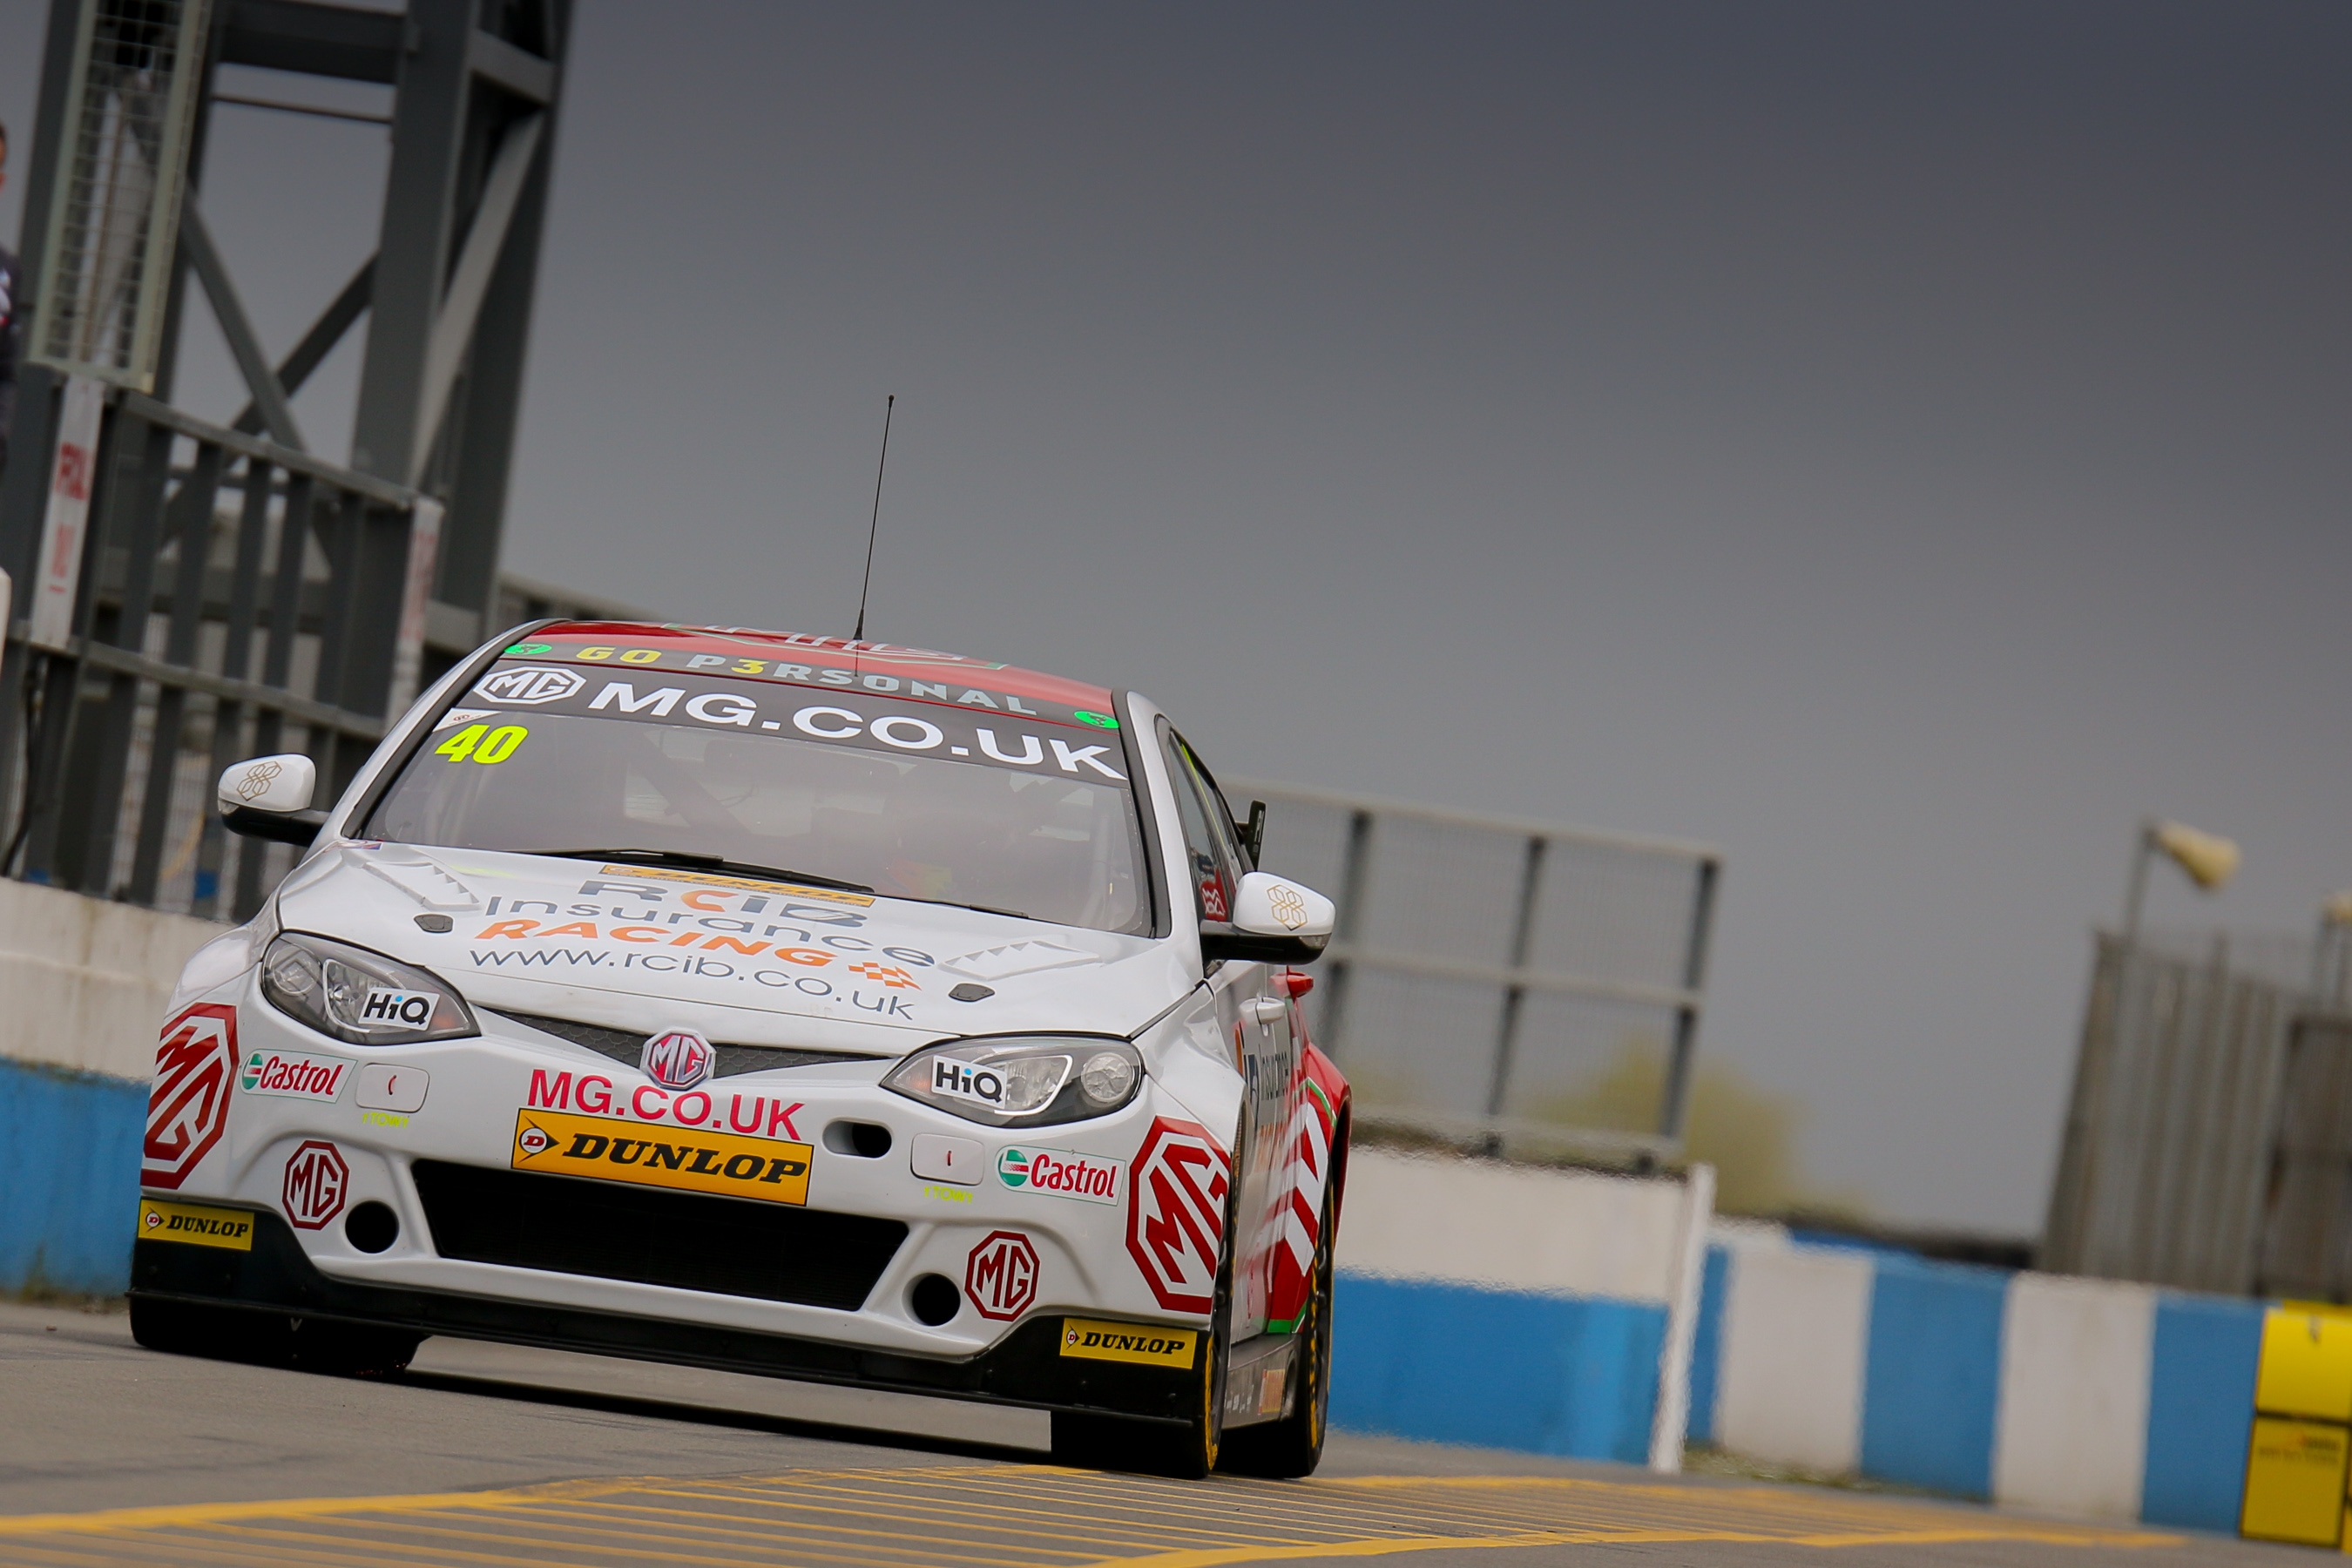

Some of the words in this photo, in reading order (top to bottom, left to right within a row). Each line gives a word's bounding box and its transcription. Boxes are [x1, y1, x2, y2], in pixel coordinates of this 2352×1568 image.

[576, 646, 661, 665] GO
[686, 653, 1037, 715] P3RSONAL
[435, 724, 529, 764] 40
[483, 670, 577, 700] MG
[588, 681, 1127, 781] MG.CO.UK
[474, 920, 837, 968] RACING
[484, 896, 936, 967] Insurance
[363, 991, 430, 1025] HiQ
[468, 948, 916, 1021] www.rcib.co.uk
[260, 1055, 343, 1097] Castrol
[647, 1032, 707, 1086] MG
[936, 1061, 1003, 1102] HiQ
[142, 1019, 229, 1166] MG
[527, 1068, 805, 1141] MG.CO.UK
[562, 1132, 807, 1184] DUNLOP
[1031, 1152, 1117, 1200] Castrol
[286, 1150, 347, 1222] MG
[166, 1214, 249, 1237] DUNLOP
[971, 1240, 1035, 1314] MG
[1081, 1331, 1186, 1355] DUNLOP
